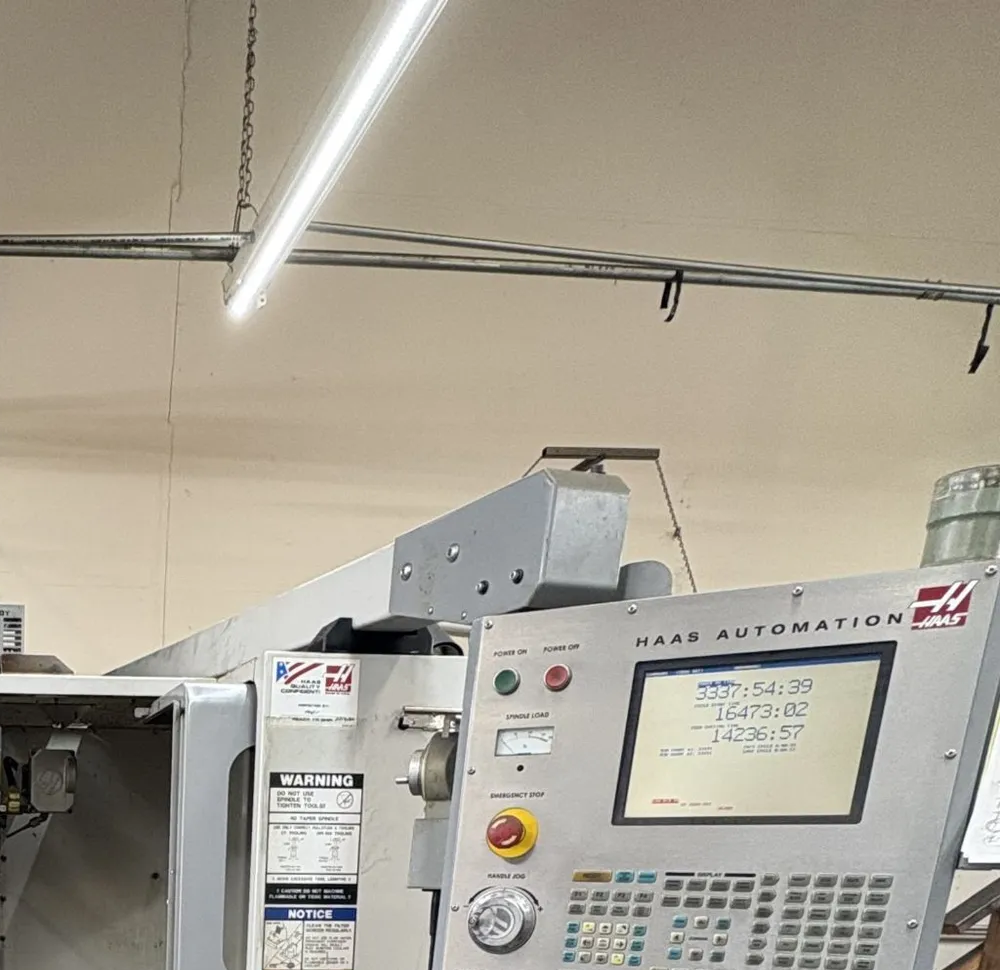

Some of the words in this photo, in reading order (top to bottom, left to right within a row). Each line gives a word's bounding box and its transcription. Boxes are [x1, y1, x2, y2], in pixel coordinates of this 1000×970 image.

[911, 612, 968, 628] HAAS
[635, 631, 699, 648] HAAS
[716, 613, 903, 641] AUTOMATION
[543, 645, 566, 654] POWER
[695, 678, 813, 700] 3337:54:39
[715, 702, 809, 721] 16473:02
[711, 724, 805, 743] 14236:57
[280, 774, 353, 787] WARNING
[288, 909, 333, 919] NOTICE
